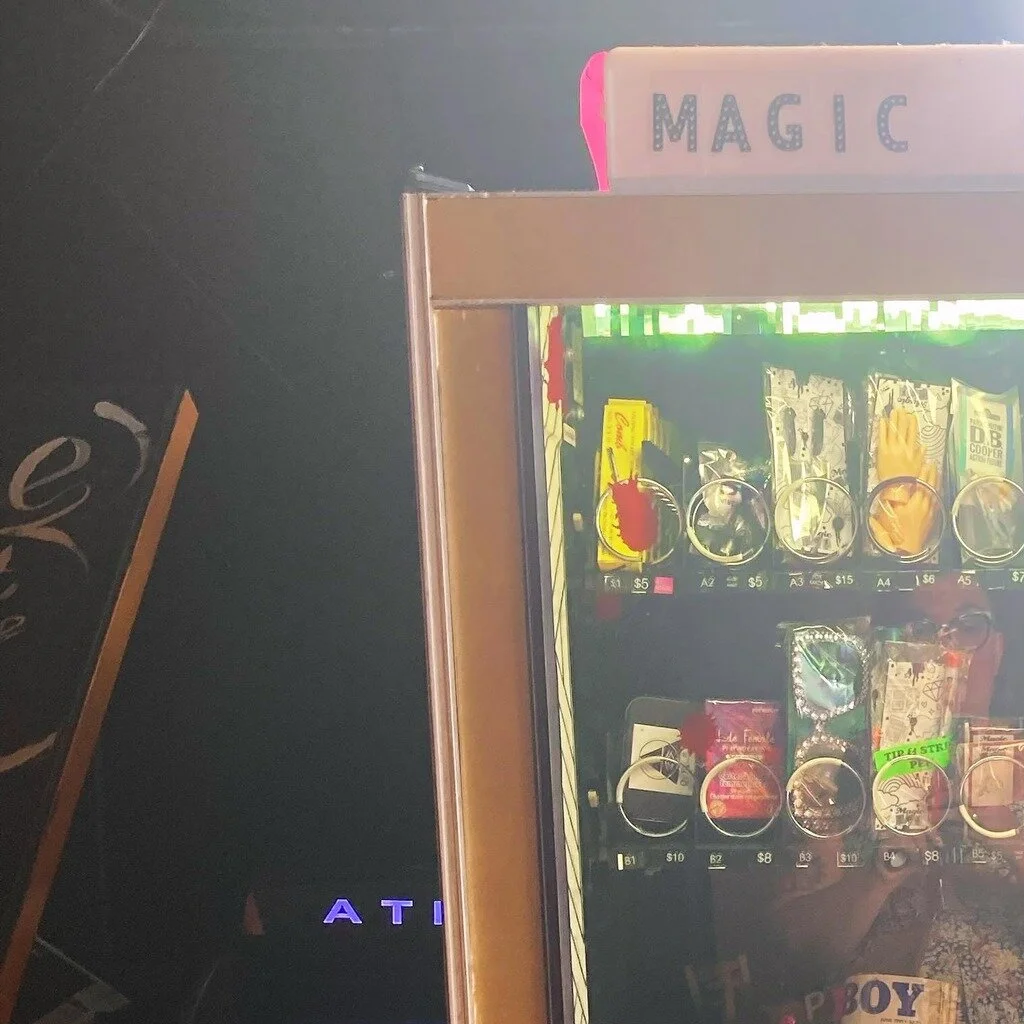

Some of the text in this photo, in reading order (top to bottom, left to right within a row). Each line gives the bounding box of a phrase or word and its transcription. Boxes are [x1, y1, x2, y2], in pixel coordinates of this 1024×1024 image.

[651, 92, 910, 154] MAGIC
[633, 577, 650, 590] $5
[700, 576, 716, 588] A2
[747, 575, 764, 588] $5
[789, 578, 804, 588] A3
[835, 575, 854, 586] $15
[876, 574, 936, 588] A4 $6
[957, 574, 973, 585] A5
[624, 853, 685, 866] B1 $10
[709, 852, 773, 864] B2 $8
[799, 852, 858, 864] B3 $10
[924, 851, 940, 862] $8
[323, 898, 445, 926] AT
